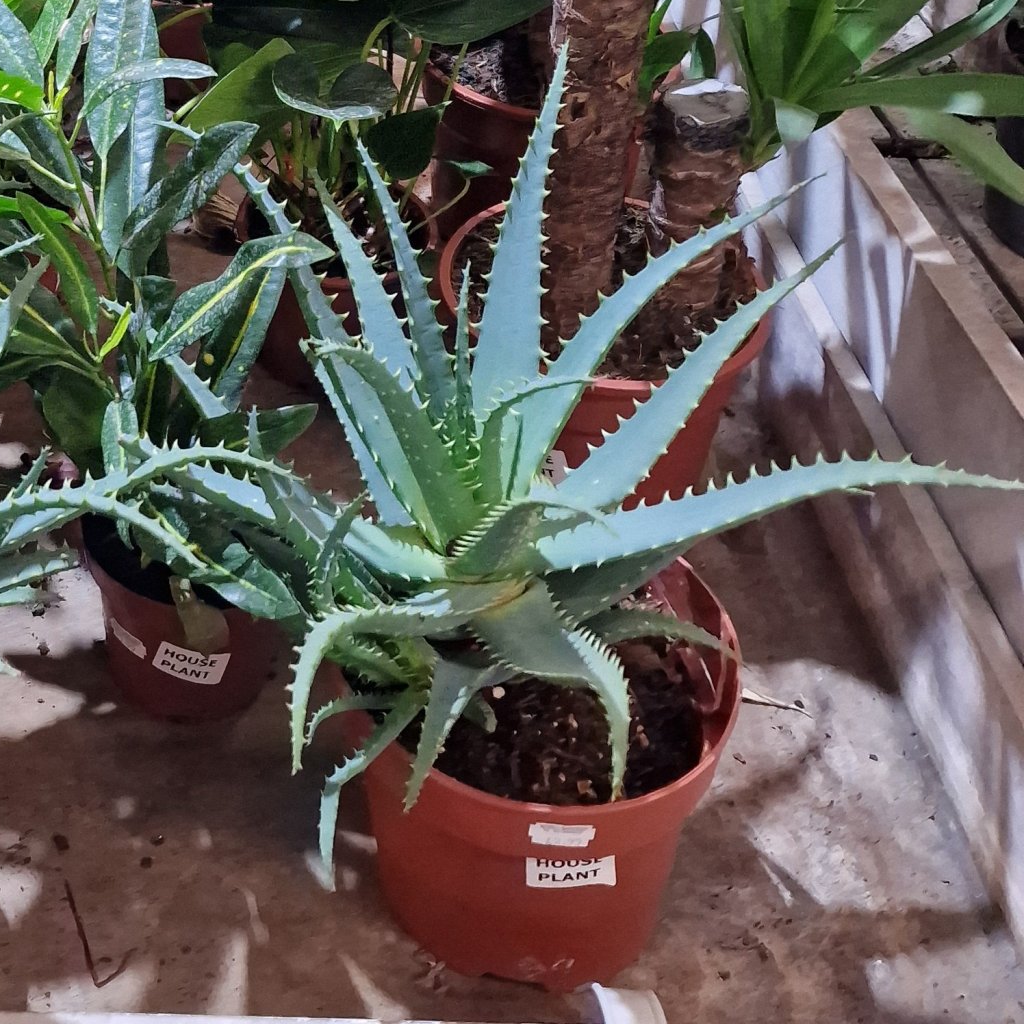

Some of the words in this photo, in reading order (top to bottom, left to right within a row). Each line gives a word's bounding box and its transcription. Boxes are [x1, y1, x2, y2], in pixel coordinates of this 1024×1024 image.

[164, 648, 218, 668] HOUSE
[160, 659, 211, 680] PLANT
[536, 857, 602, 869] HOUSE
[538, 867, 601, 882] PLANT
